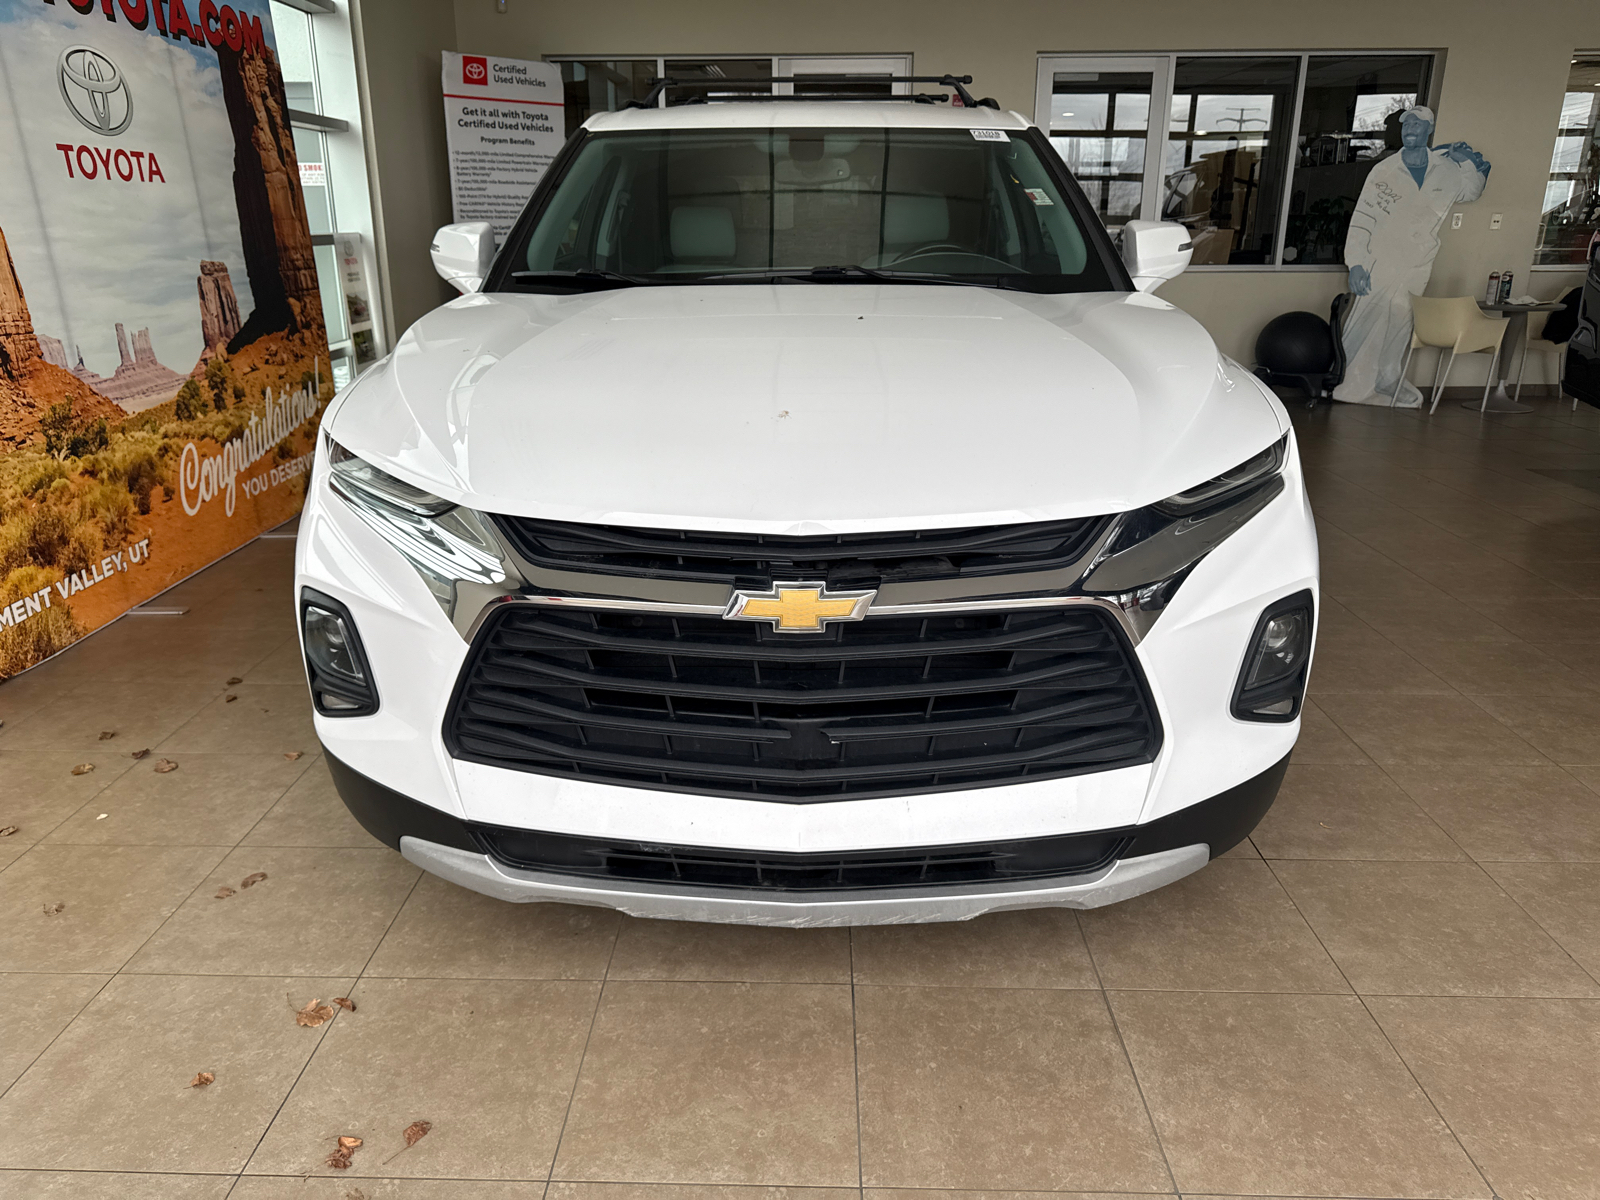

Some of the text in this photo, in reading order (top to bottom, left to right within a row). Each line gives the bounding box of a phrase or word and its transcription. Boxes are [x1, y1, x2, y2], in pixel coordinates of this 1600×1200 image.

[493, 64, 527, 75] Certified
[494, 75, 546, 87] Used Vehicles
[462, 107, 549, 122] Get it all with Toyota
[458, 119, 554, 133] Certified Used Vehicles
[480, 136, 535, 146] Program Benefits
[55, 143, 165, 184] TOYOTA
[180, 355, 321, 517] Congratulations!
[242, 473, 268, 499] YOU
[55, 551, 128, 600] VALLEY,
[128, 538, 149, 564] UT
